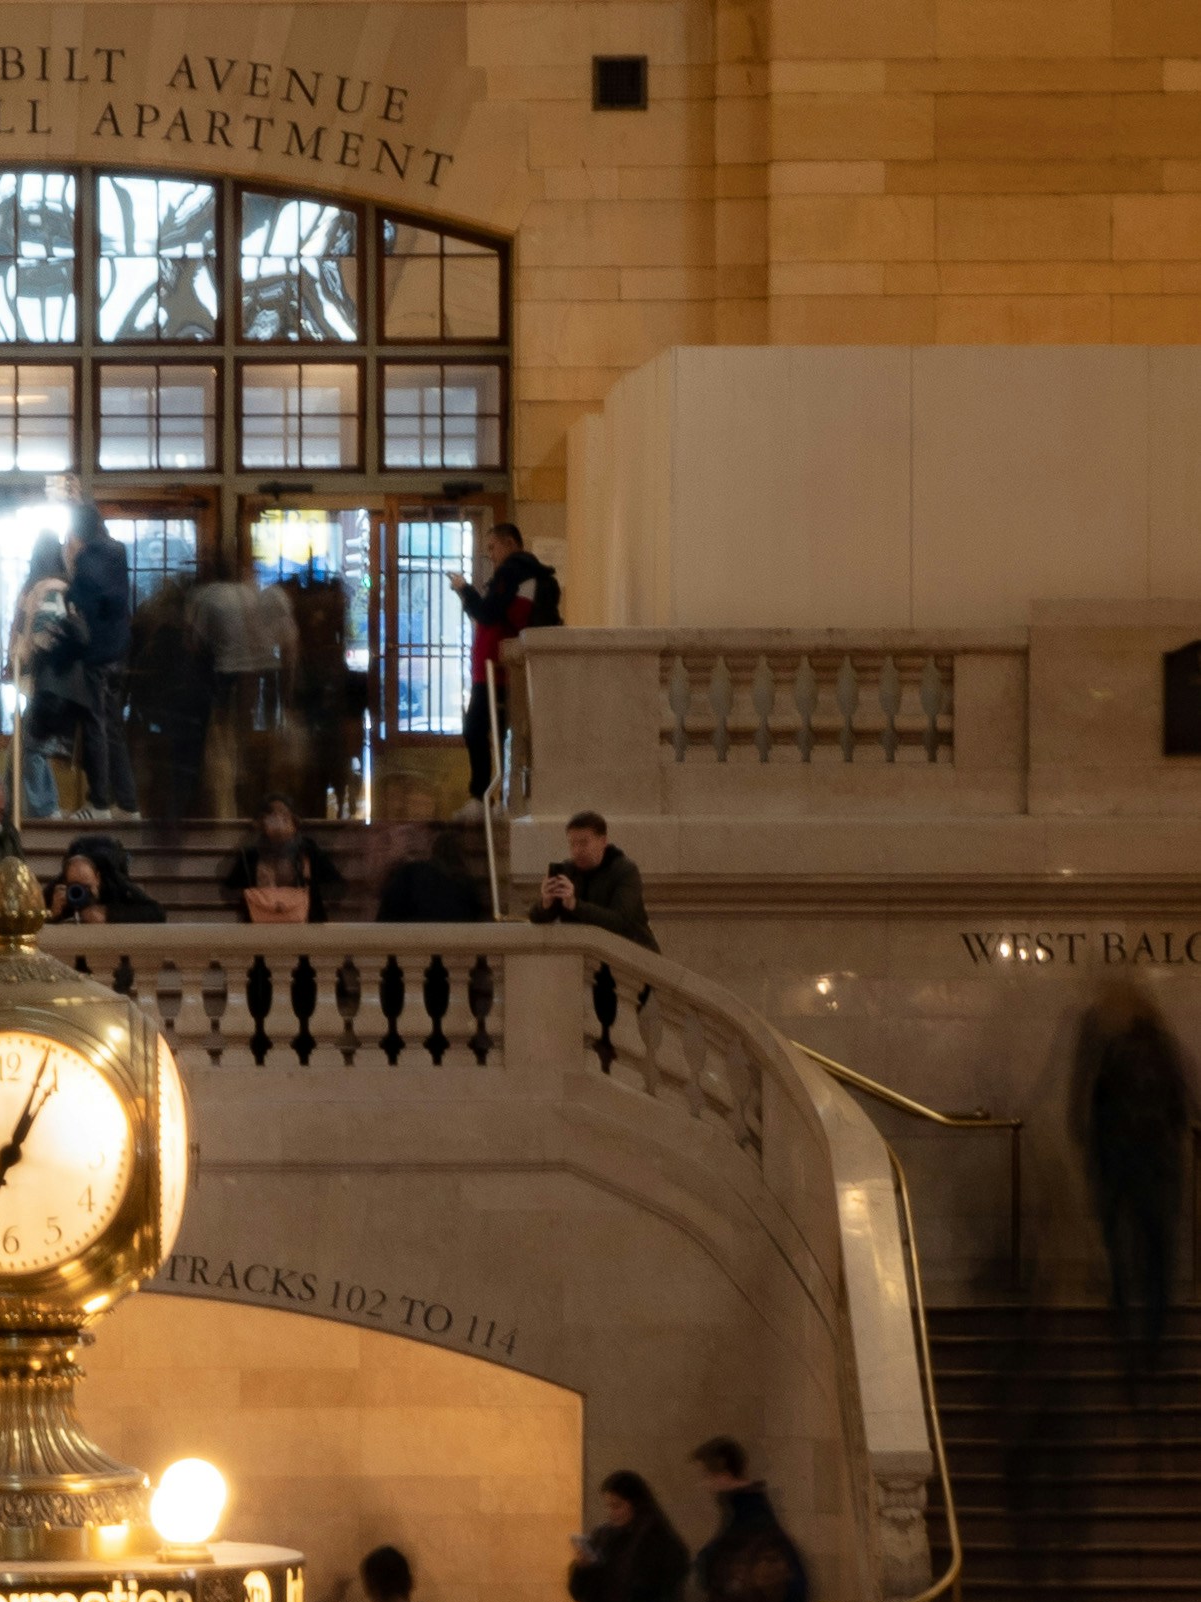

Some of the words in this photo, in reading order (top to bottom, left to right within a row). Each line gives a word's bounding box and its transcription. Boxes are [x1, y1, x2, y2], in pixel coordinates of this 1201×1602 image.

[166, 53, 411, 124] AVENUE
[93, 101, 455, 189] APARTMENT
[959, 932, 1087, 965] WEST
[77, 1184, 96, 1213] 4
[2, 1225, 20, 1254] 6
[44, 1216, 62, 1245] 5
[165, 1255, 318, 1302] TRACKS
[330, 1280, 387, 1318] 102
[399, 1295, 453, 1334] TO
[465, 1315, 518, 1355] 114
